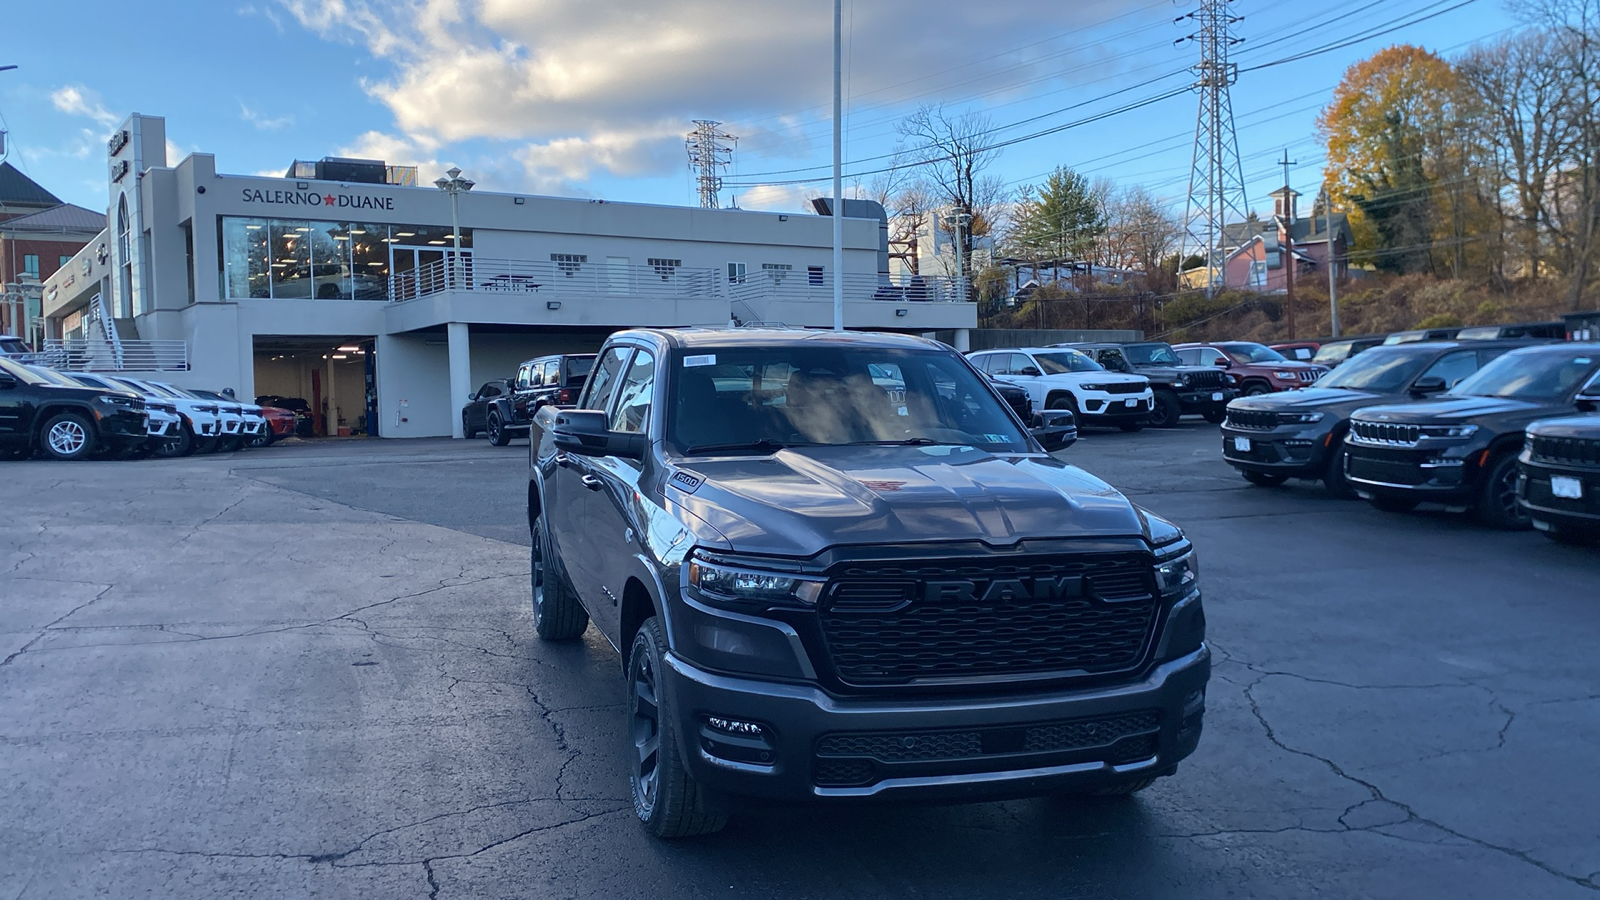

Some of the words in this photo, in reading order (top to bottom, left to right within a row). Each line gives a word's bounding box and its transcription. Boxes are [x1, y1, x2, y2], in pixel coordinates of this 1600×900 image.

[242, 188, 321, 206] SALERNO
[338, 194, 394, 210] DUANE
[677, 473, 698, 486] 1500
[925, 576, 1083, 601] RAM
